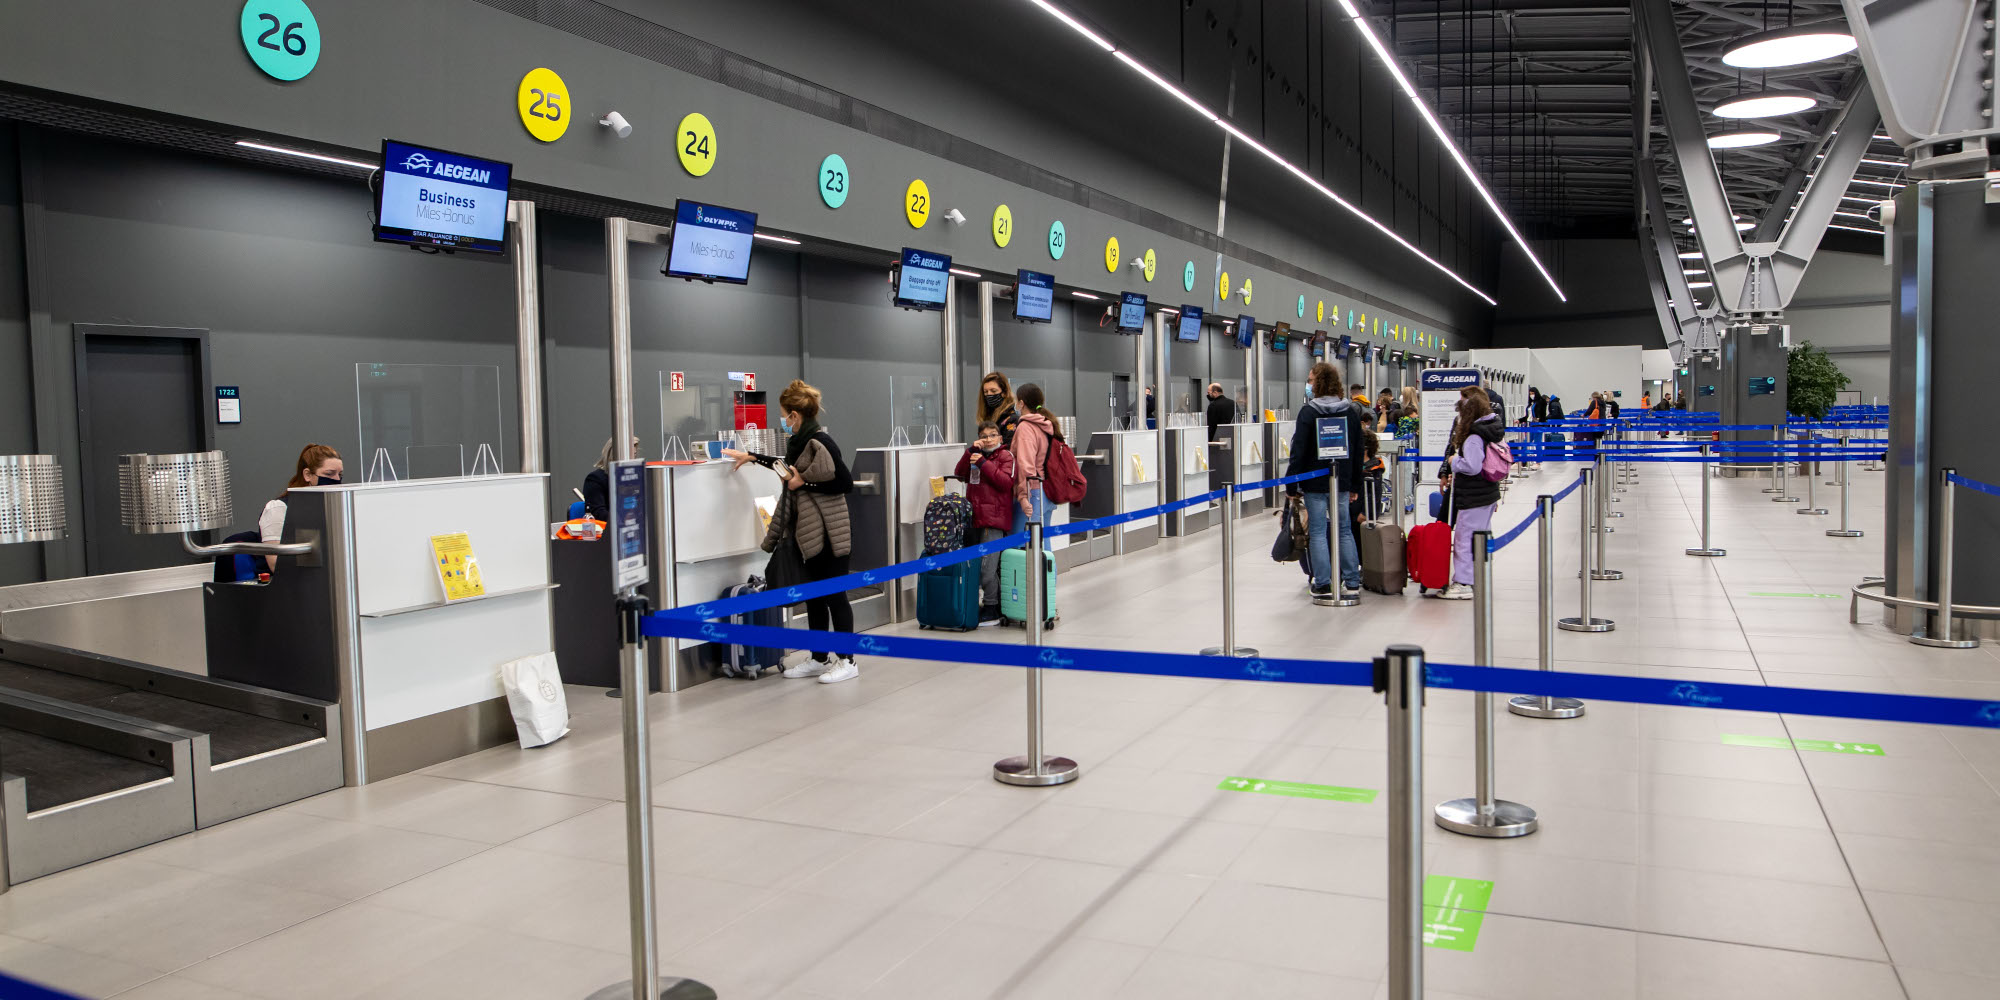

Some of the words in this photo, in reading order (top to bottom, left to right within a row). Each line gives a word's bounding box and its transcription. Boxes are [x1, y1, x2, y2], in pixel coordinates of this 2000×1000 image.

[257, 12, 307, 57] 26
[529, 88, 561, 122] 25
[685, 130, 709, 160] 24
[434, 162, 490, 183] AEGEAN
[826, 170, 844, 193] 23
[420, 189, 475, 209] Business
[911, 194, 925, 215] 22
[704, 216, 737, 227] OLYMPIC
[998, 217, 1008, 235] 21
[427, 232, 452, 240] ALLIANCE
[1053, 231, 1062, 248] 20
[920, 258, 943, 269] AEGEAN
[1110, 248, 1116, 262] 19
[908, 275, 925, 284] Baggage
[926, 278, 934, 286] drop
